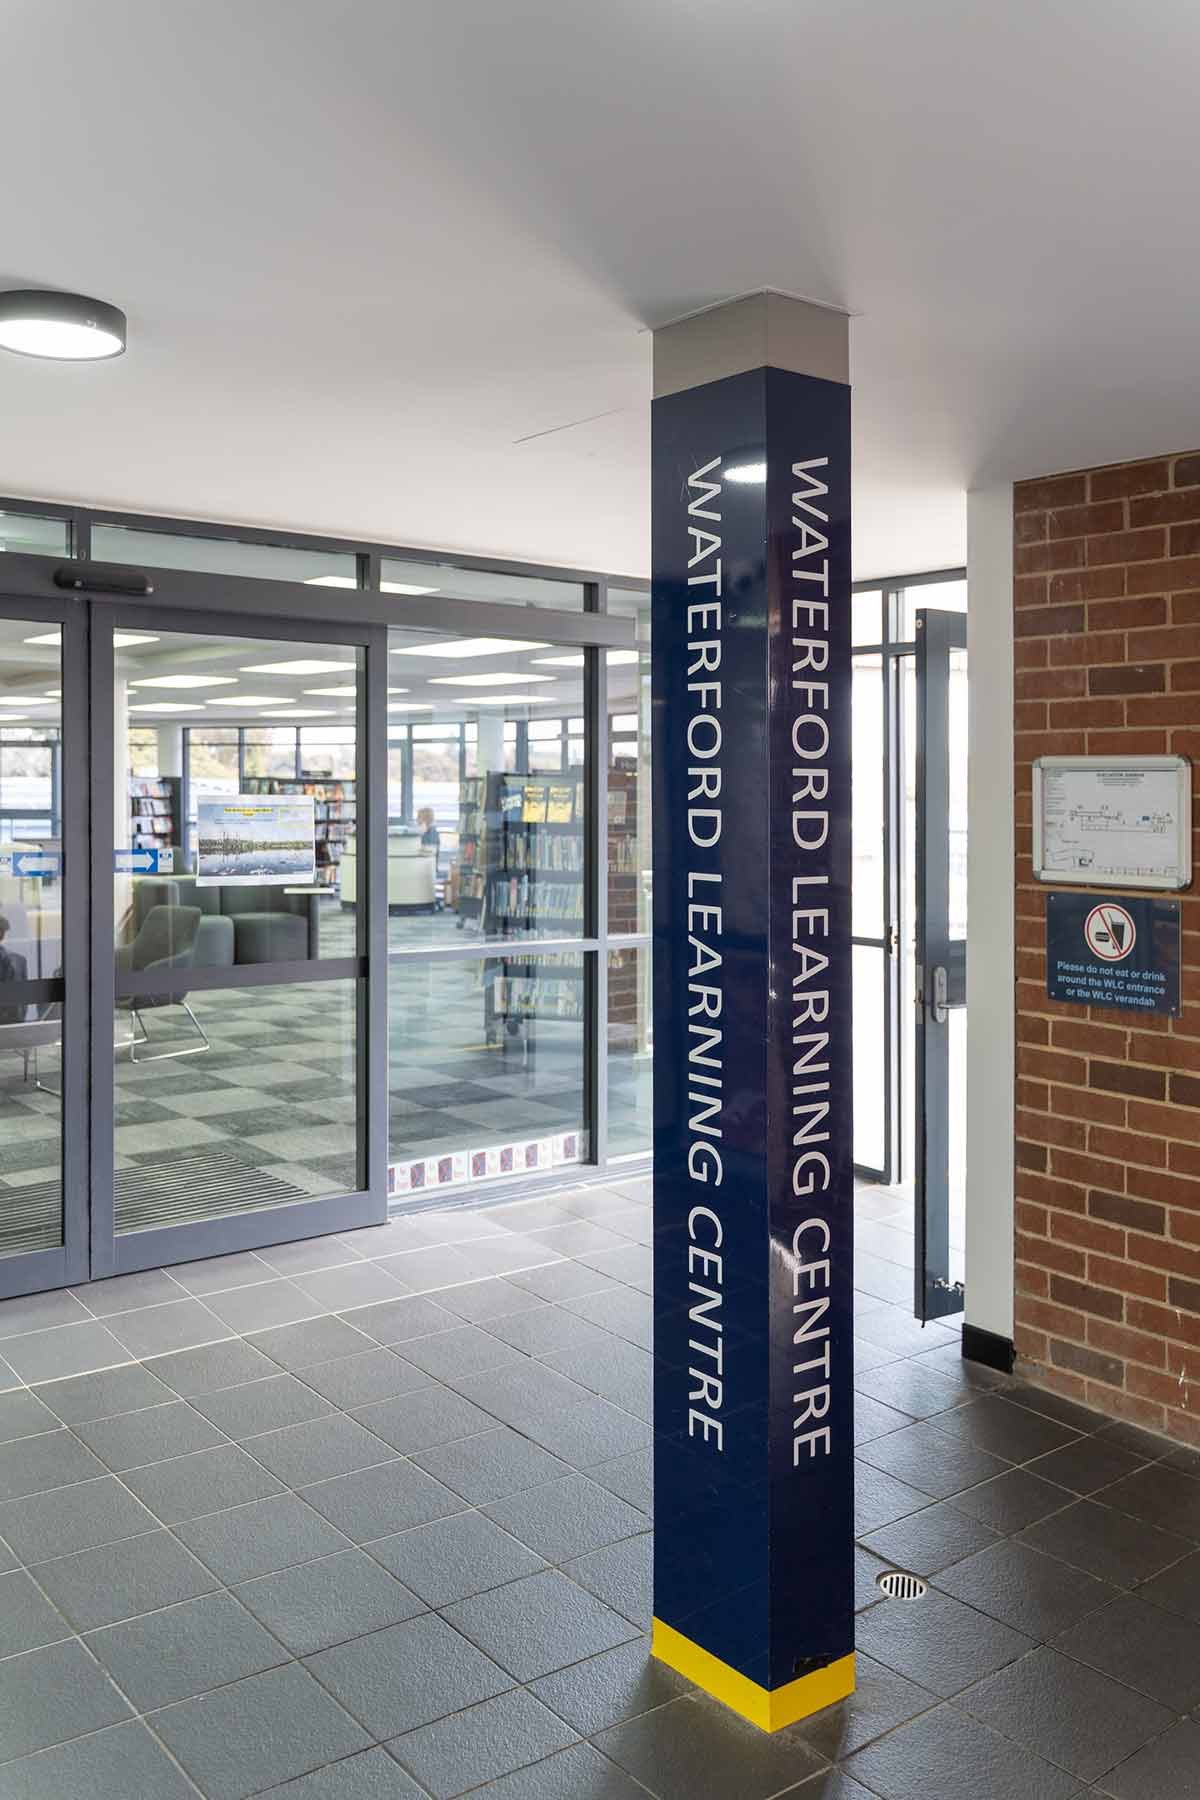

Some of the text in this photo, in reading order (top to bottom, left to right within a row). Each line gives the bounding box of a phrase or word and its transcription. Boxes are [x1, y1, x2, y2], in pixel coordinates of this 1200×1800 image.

[687, 456, 724, 1452] WATERFORD LEARNING CENTRE
[791, 456, 831, 1466] WATERFORD LEARNING CENTRE
[1057, 961, 1084, 972] Please
[1086, 964, 1097, 973] do
[1099, 966, 1113, 976] not
[1115, 968, 1128, 978] eat
[1142, 970, 1166, 982] drink
[1057, 975, 1165, 995] around the WLC entrance
[1077, 988, 1090, 998] the
[1092, 990, 1113, 1001] WLC
[1114, 994, 1155, 1006] verandah
